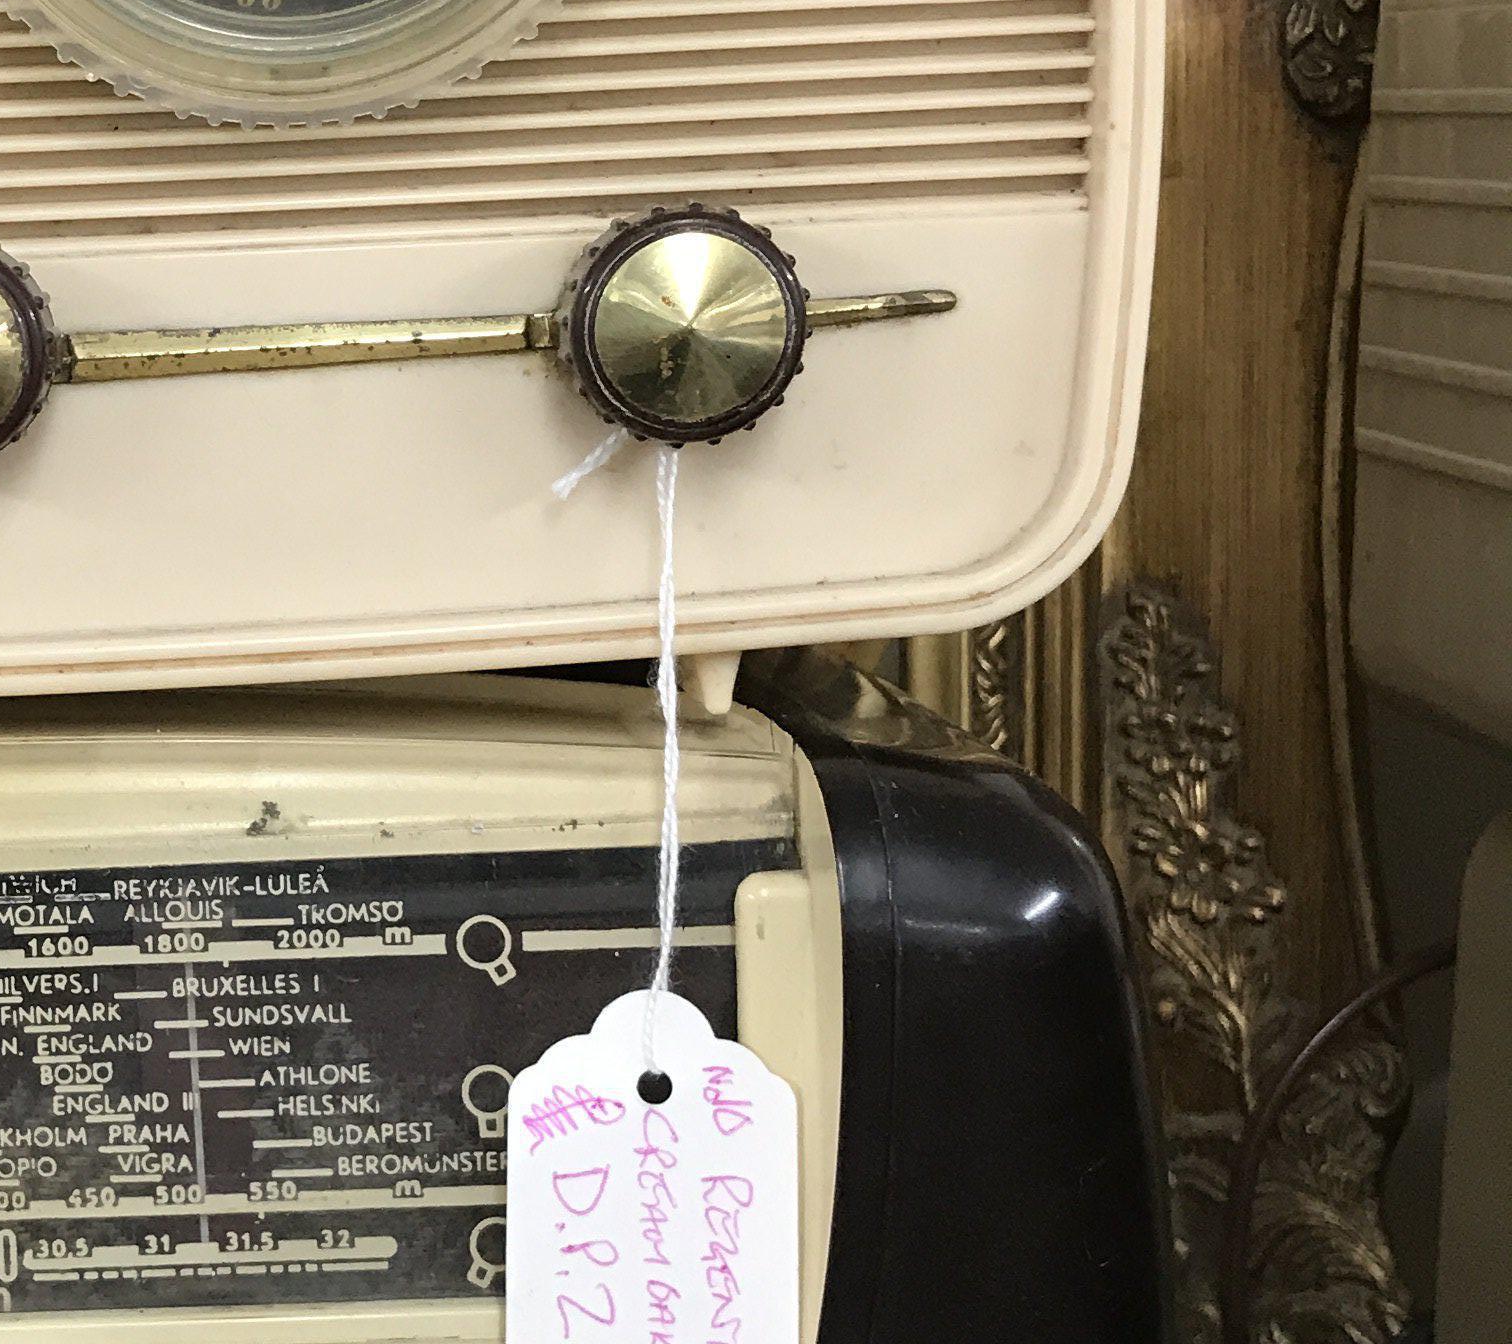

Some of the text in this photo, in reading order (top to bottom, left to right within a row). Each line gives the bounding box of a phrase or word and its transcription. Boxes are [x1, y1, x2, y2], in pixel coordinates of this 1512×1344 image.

[124, 899, 224, 923] ALLOUIS
[27, 936, 90, 957] 1600
[144, 932, 206, 953] 1800
[276, 929, 341, 950] 2000
[384, 925, 412, 944] m
[172, 973, 301, 998] BRUXELLES
[0, 1002, 122, 1027] FINNMARK
[212, 1004, 353, 1026] SUNDSVALL
[1, 1035, 24, 1057] N.
[37, 1030, 154, 1055] ENGLAND
[229, 1035, 291, 1057] WIEN
[259, 1062, 372, 1087] ATHLONE
[52, 1091, 169, 1116] ENGLAND
[108, 1122, 191, 1145] PRAHA
[312, 1122, 433, 1146] BUDAPEST
[117, 1151, 194, 1174] VIGRA
[154, 1184, 203, 1205] 500
[248, 1181, 297, 1203] 550
[394, 1179, 422, 1198] m
[633, 1107, 680, 1266] CREAM
[36, 1237, 90, 1259] 30.5
[144, 1234, 170, 1254] 31
[226, 1232, 274, 1252] 31.5
[317, 1229, 351, 1248] 32
